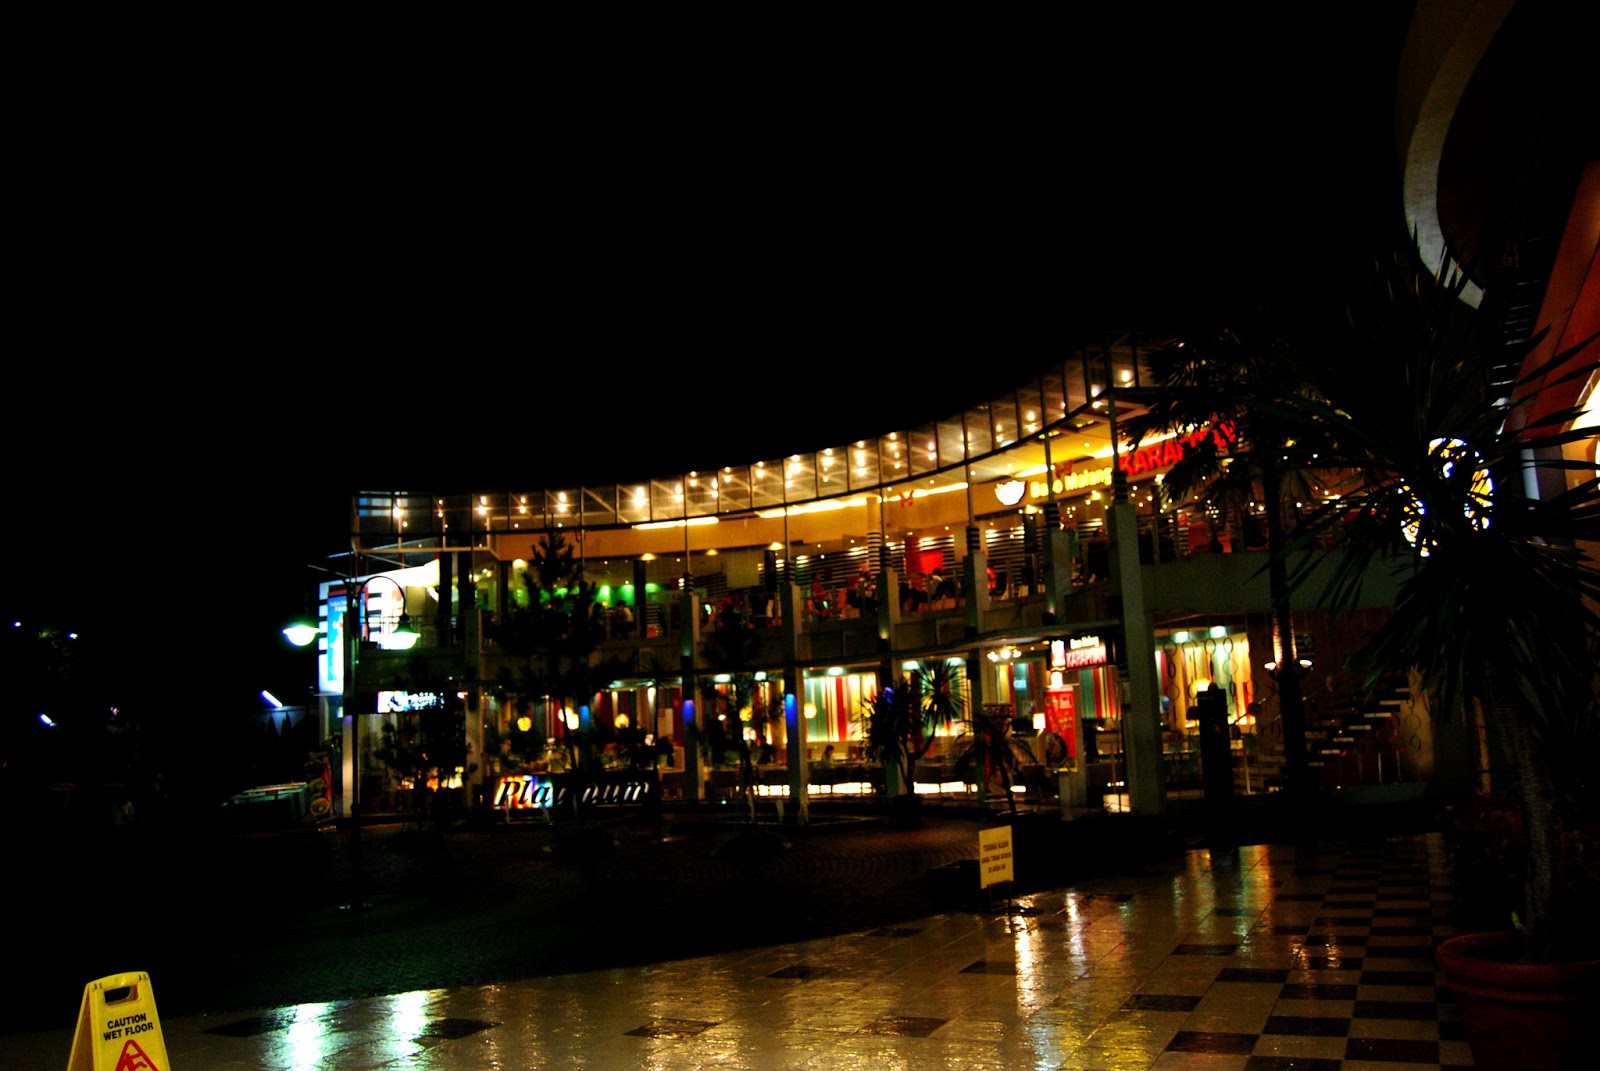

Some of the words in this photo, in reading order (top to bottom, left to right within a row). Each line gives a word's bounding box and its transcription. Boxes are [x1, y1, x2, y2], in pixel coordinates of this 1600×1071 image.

[1064, 467, 1112, 491] Malang
[107, 1013, 147, 1029] CAUTION
[103, 1029, 122, 1041] WET
[125, 1022, 154, 1036] FLOOR
